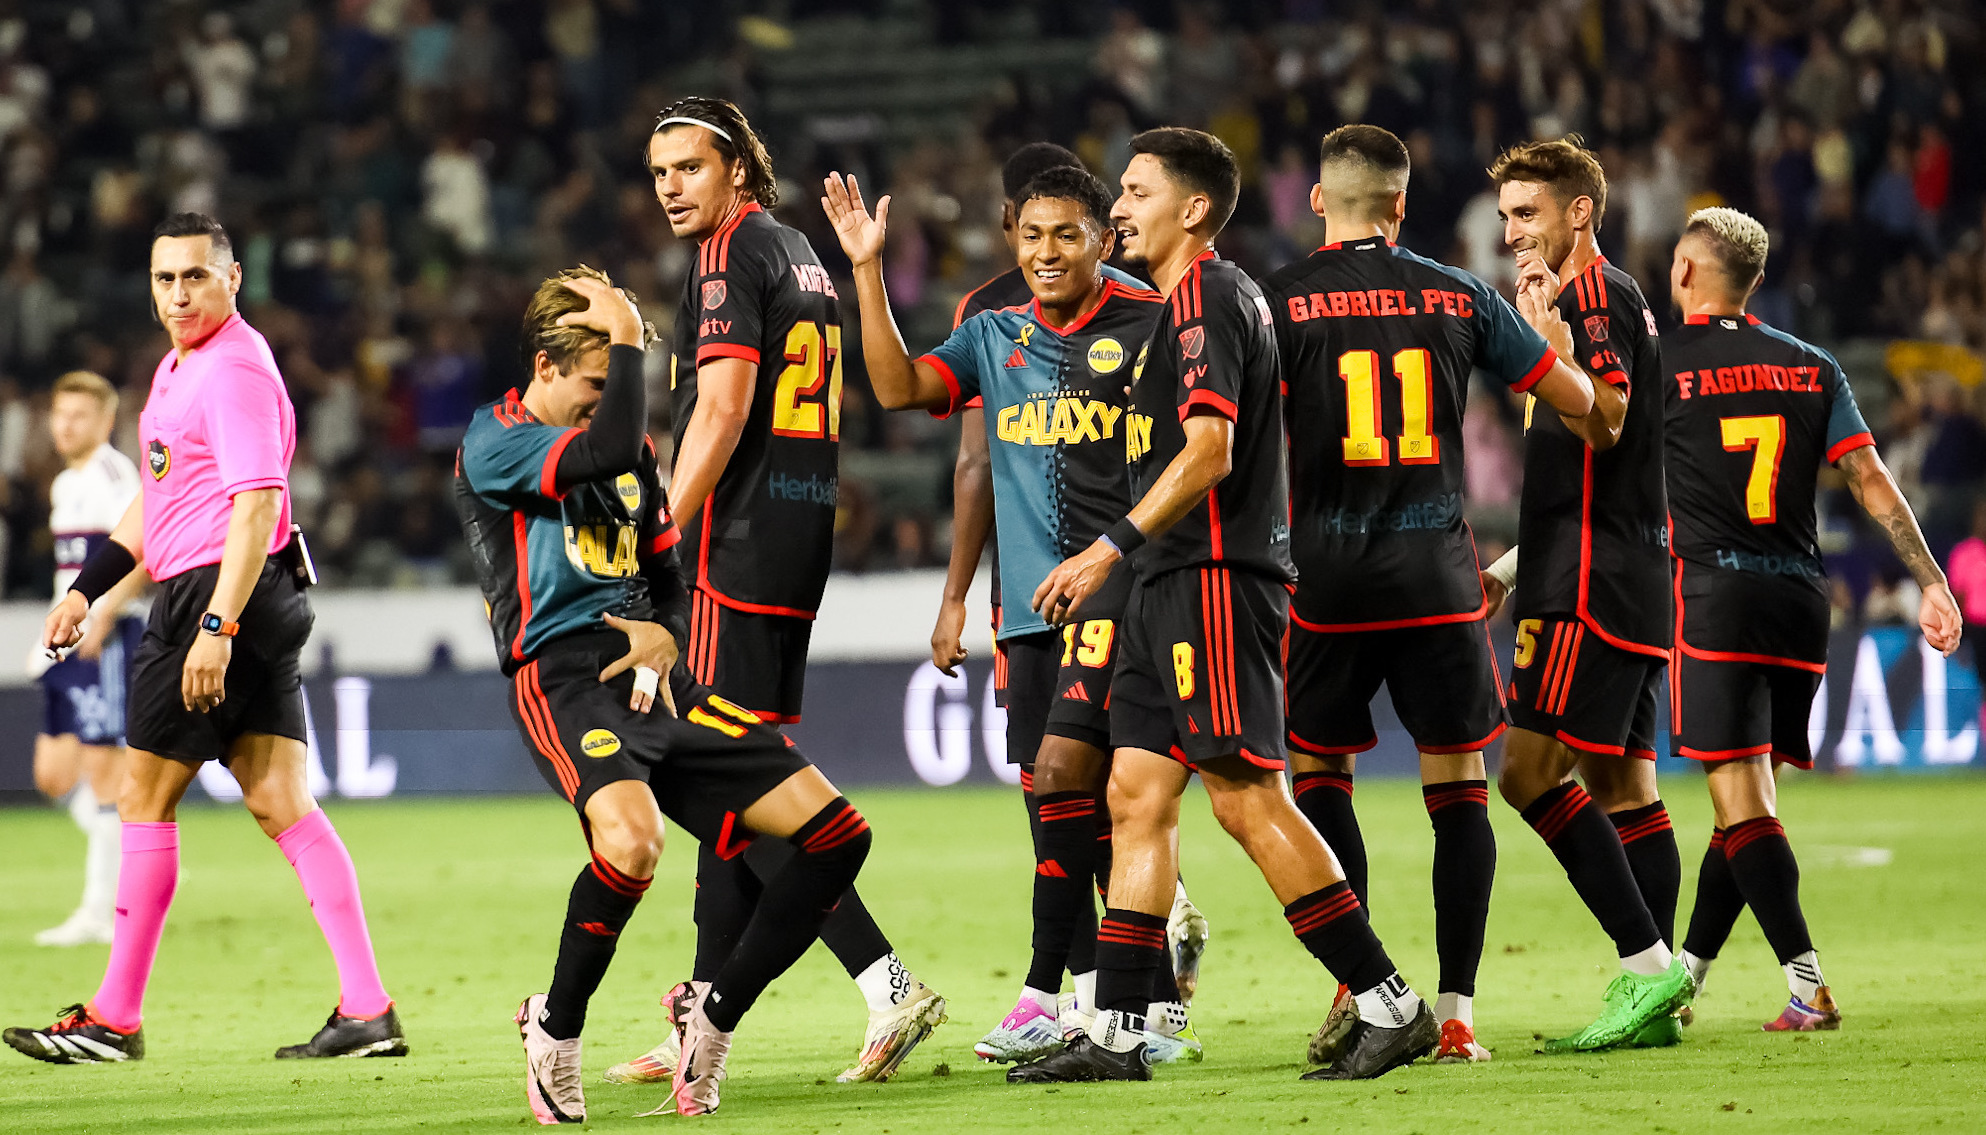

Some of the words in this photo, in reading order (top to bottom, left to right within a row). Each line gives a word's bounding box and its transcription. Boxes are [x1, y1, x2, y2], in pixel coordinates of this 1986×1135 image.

[1288, 289, 1416, 322] GABRIEL
[1421, 288, 1473, 318] PEC
[772, 321, 844, 442] 27
[1338, 347, 1440, 467] 11
[1675, 364, 1823, 400] FAGUNDEZ
[997, 398, 1122, 446] GALAXY
[1719, 413, 1787, 526] 7
[1061, 619, 1115, 669] 19
[1172, 641, 1195, 700] 8
[1807, 635, 1979, 766] AL
